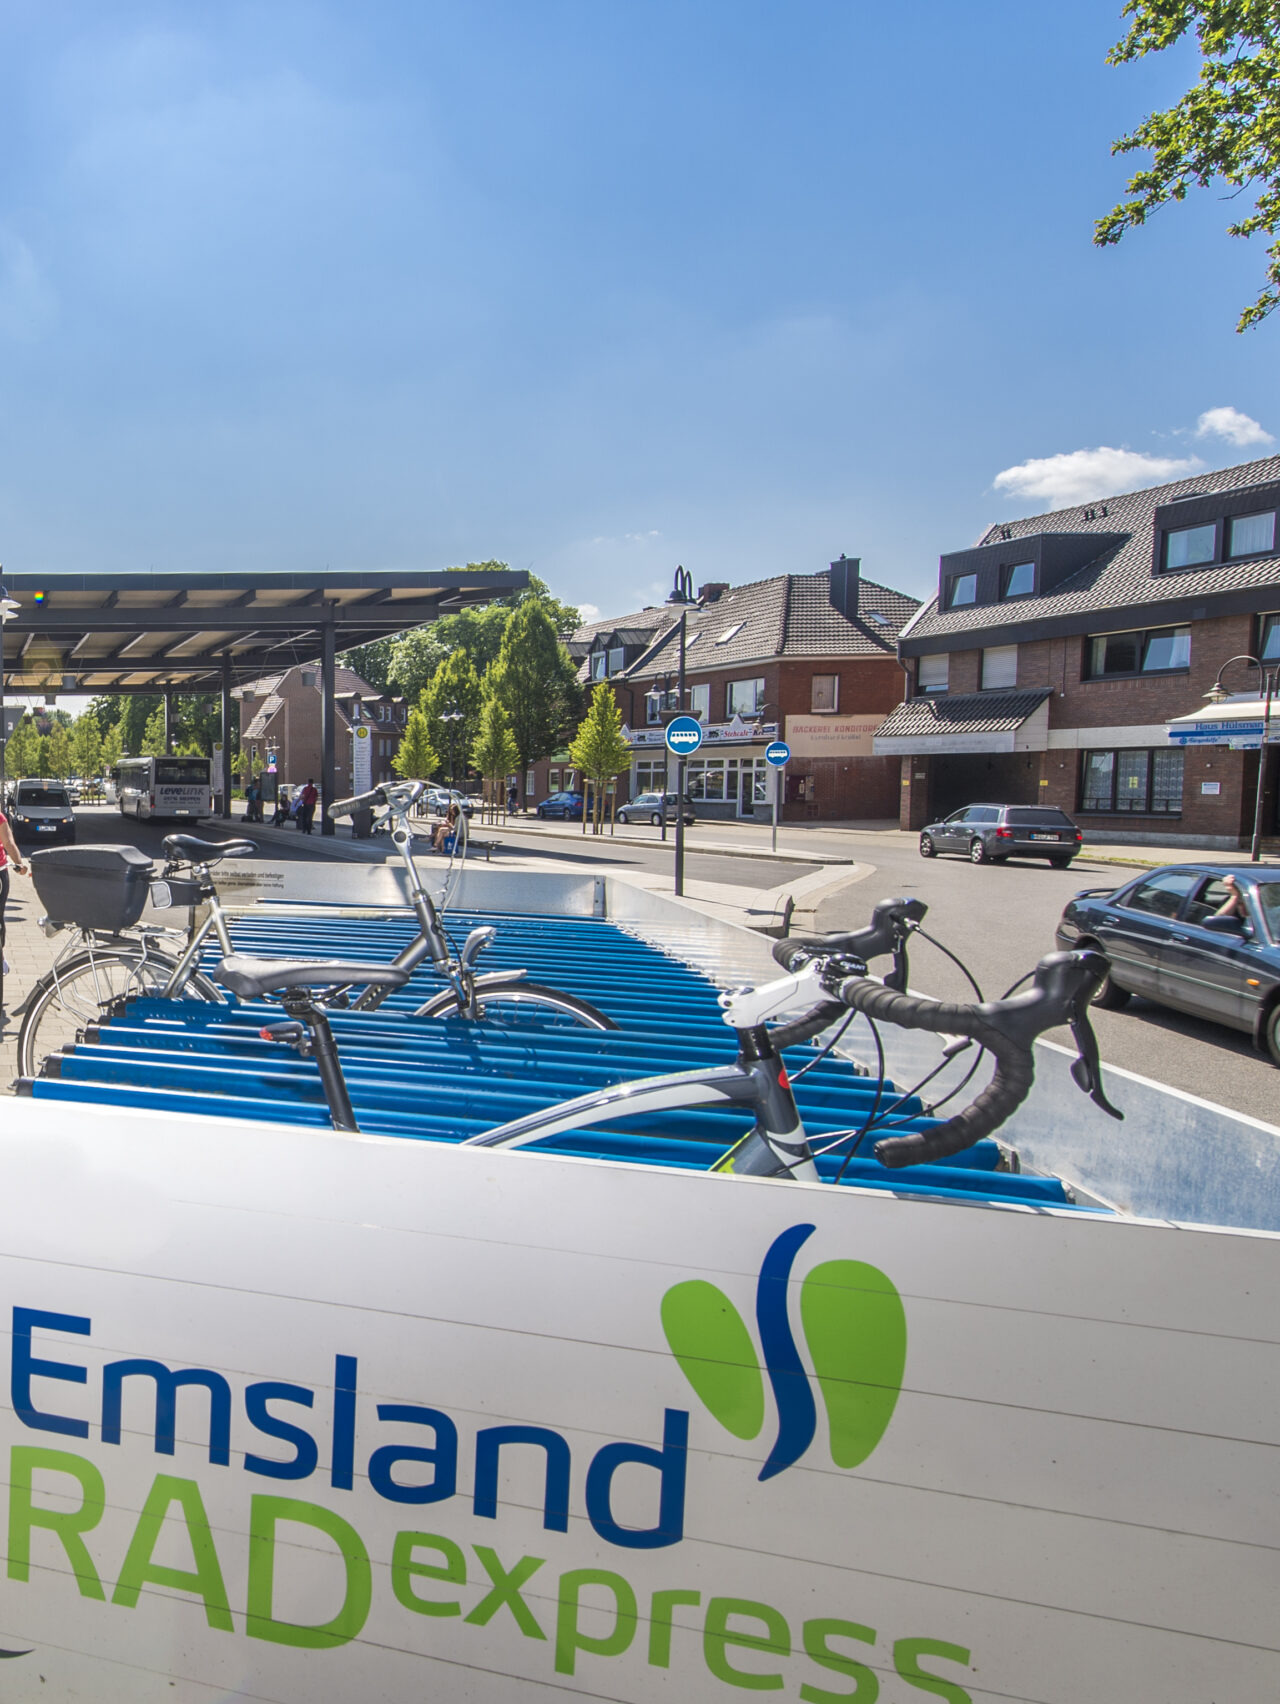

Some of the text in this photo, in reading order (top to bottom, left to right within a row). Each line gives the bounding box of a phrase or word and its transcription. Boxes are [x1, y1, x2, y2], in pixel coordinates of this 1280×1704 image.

[1195, 722, 1218, 730] Haus
[839, 960, 866, 971] GIANT
[11, 1306, 689, 1549] Emsland
